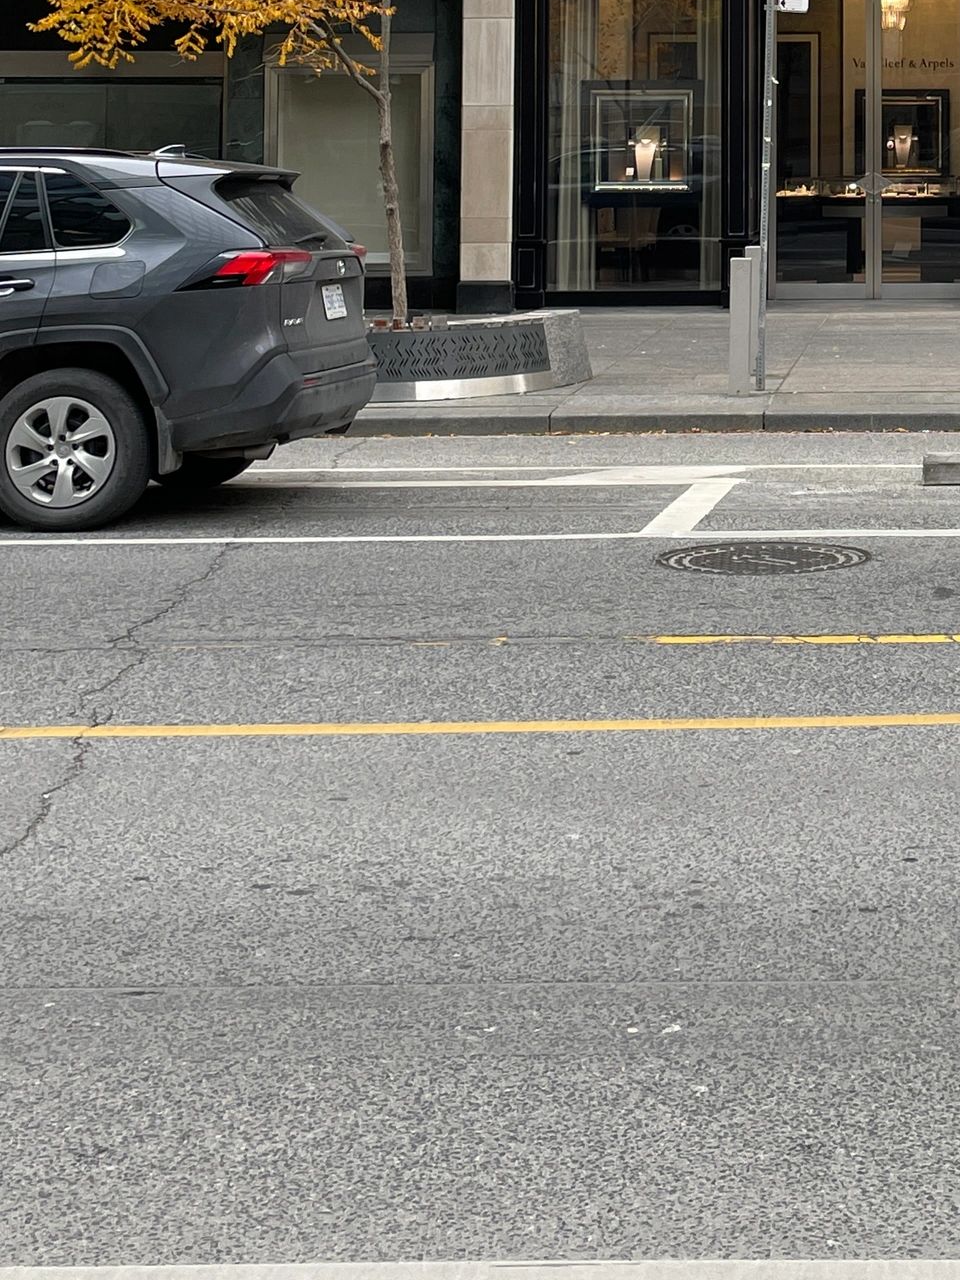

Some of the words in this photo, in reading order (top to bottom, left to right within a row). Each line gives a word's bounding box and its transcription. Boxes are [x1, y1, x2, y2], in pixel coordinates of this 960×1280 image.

[882, 57, 906, 69] leef
[908, 60, 917, 69] &
[920, 58, 954, 71] Arpels
